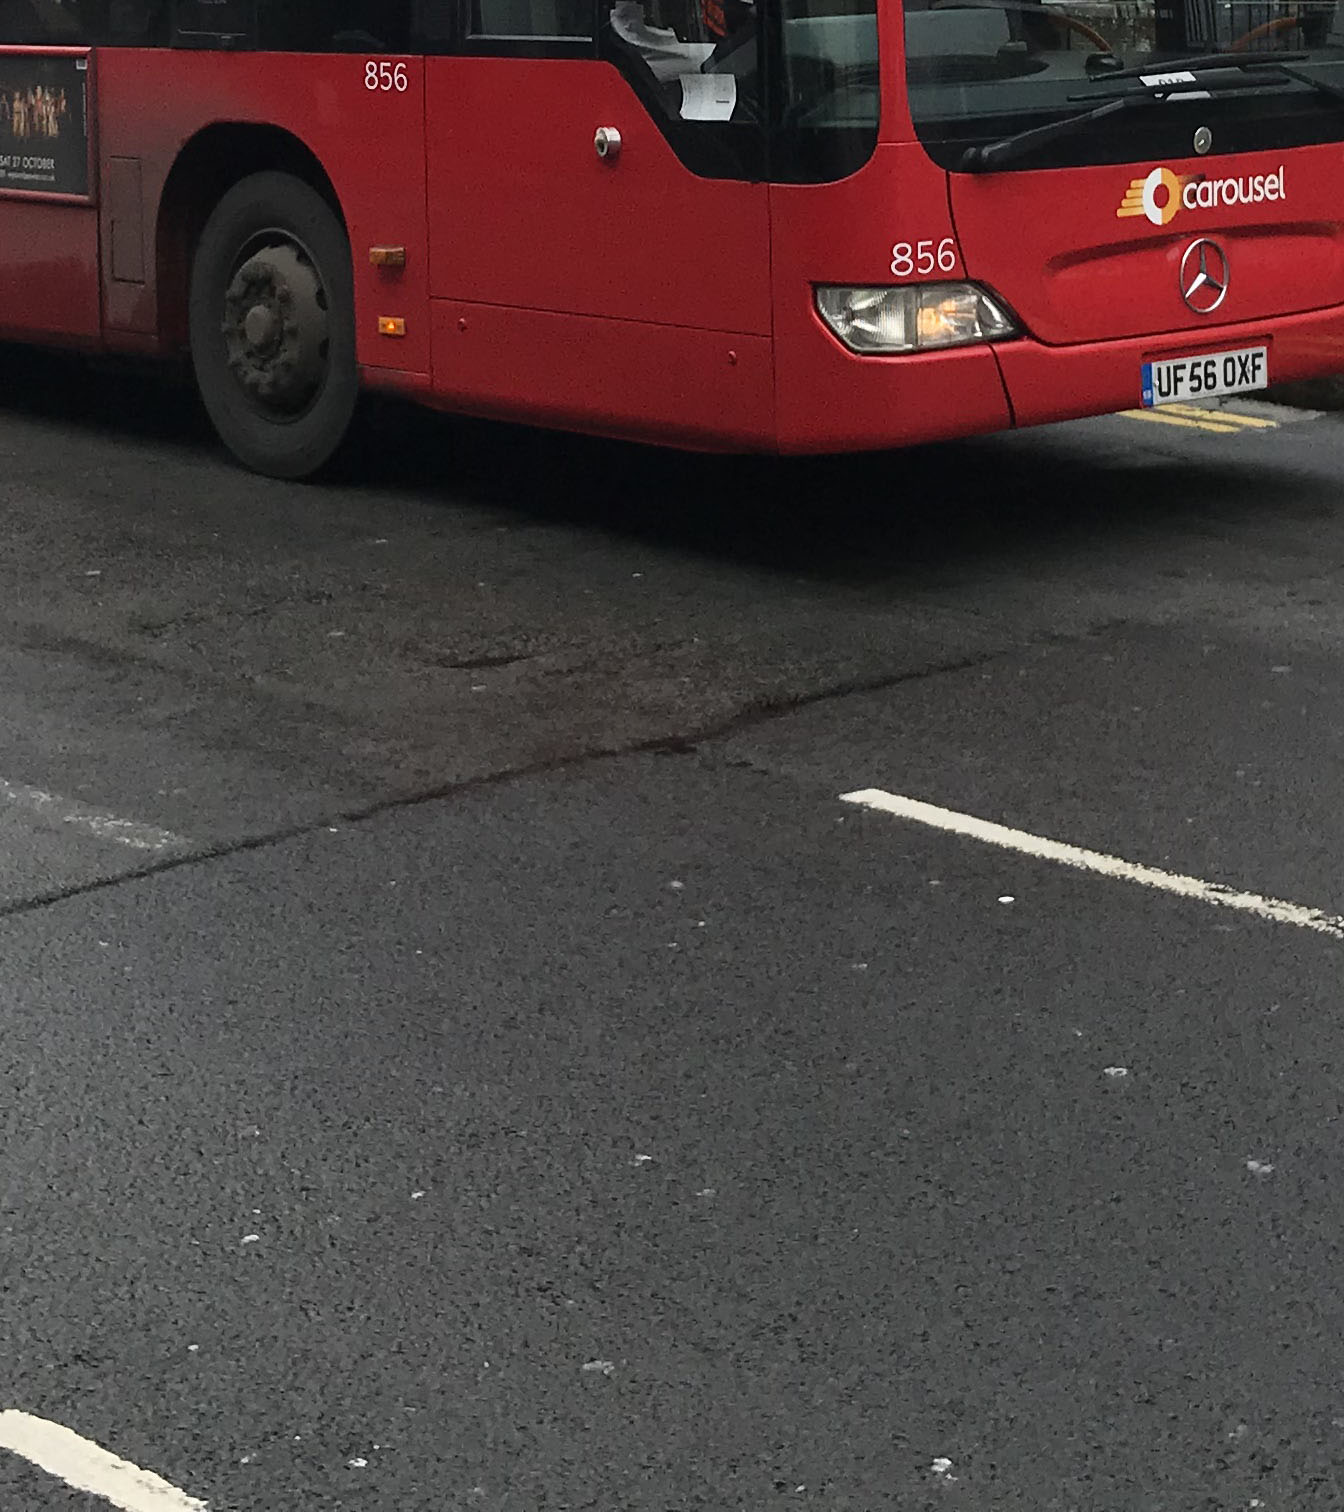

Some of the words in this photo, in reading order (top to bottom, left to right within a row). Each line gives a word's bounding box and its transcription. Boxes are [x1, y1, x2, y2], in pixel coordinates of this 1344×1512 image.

[364, 62, 408, 92] 856
[1182, 165, 1286, 210] carousel
[890, 238, 955, 276] 856
[1157, 360, 1216, 397] UF56
[1223, 352, 1263, 387] OXF
